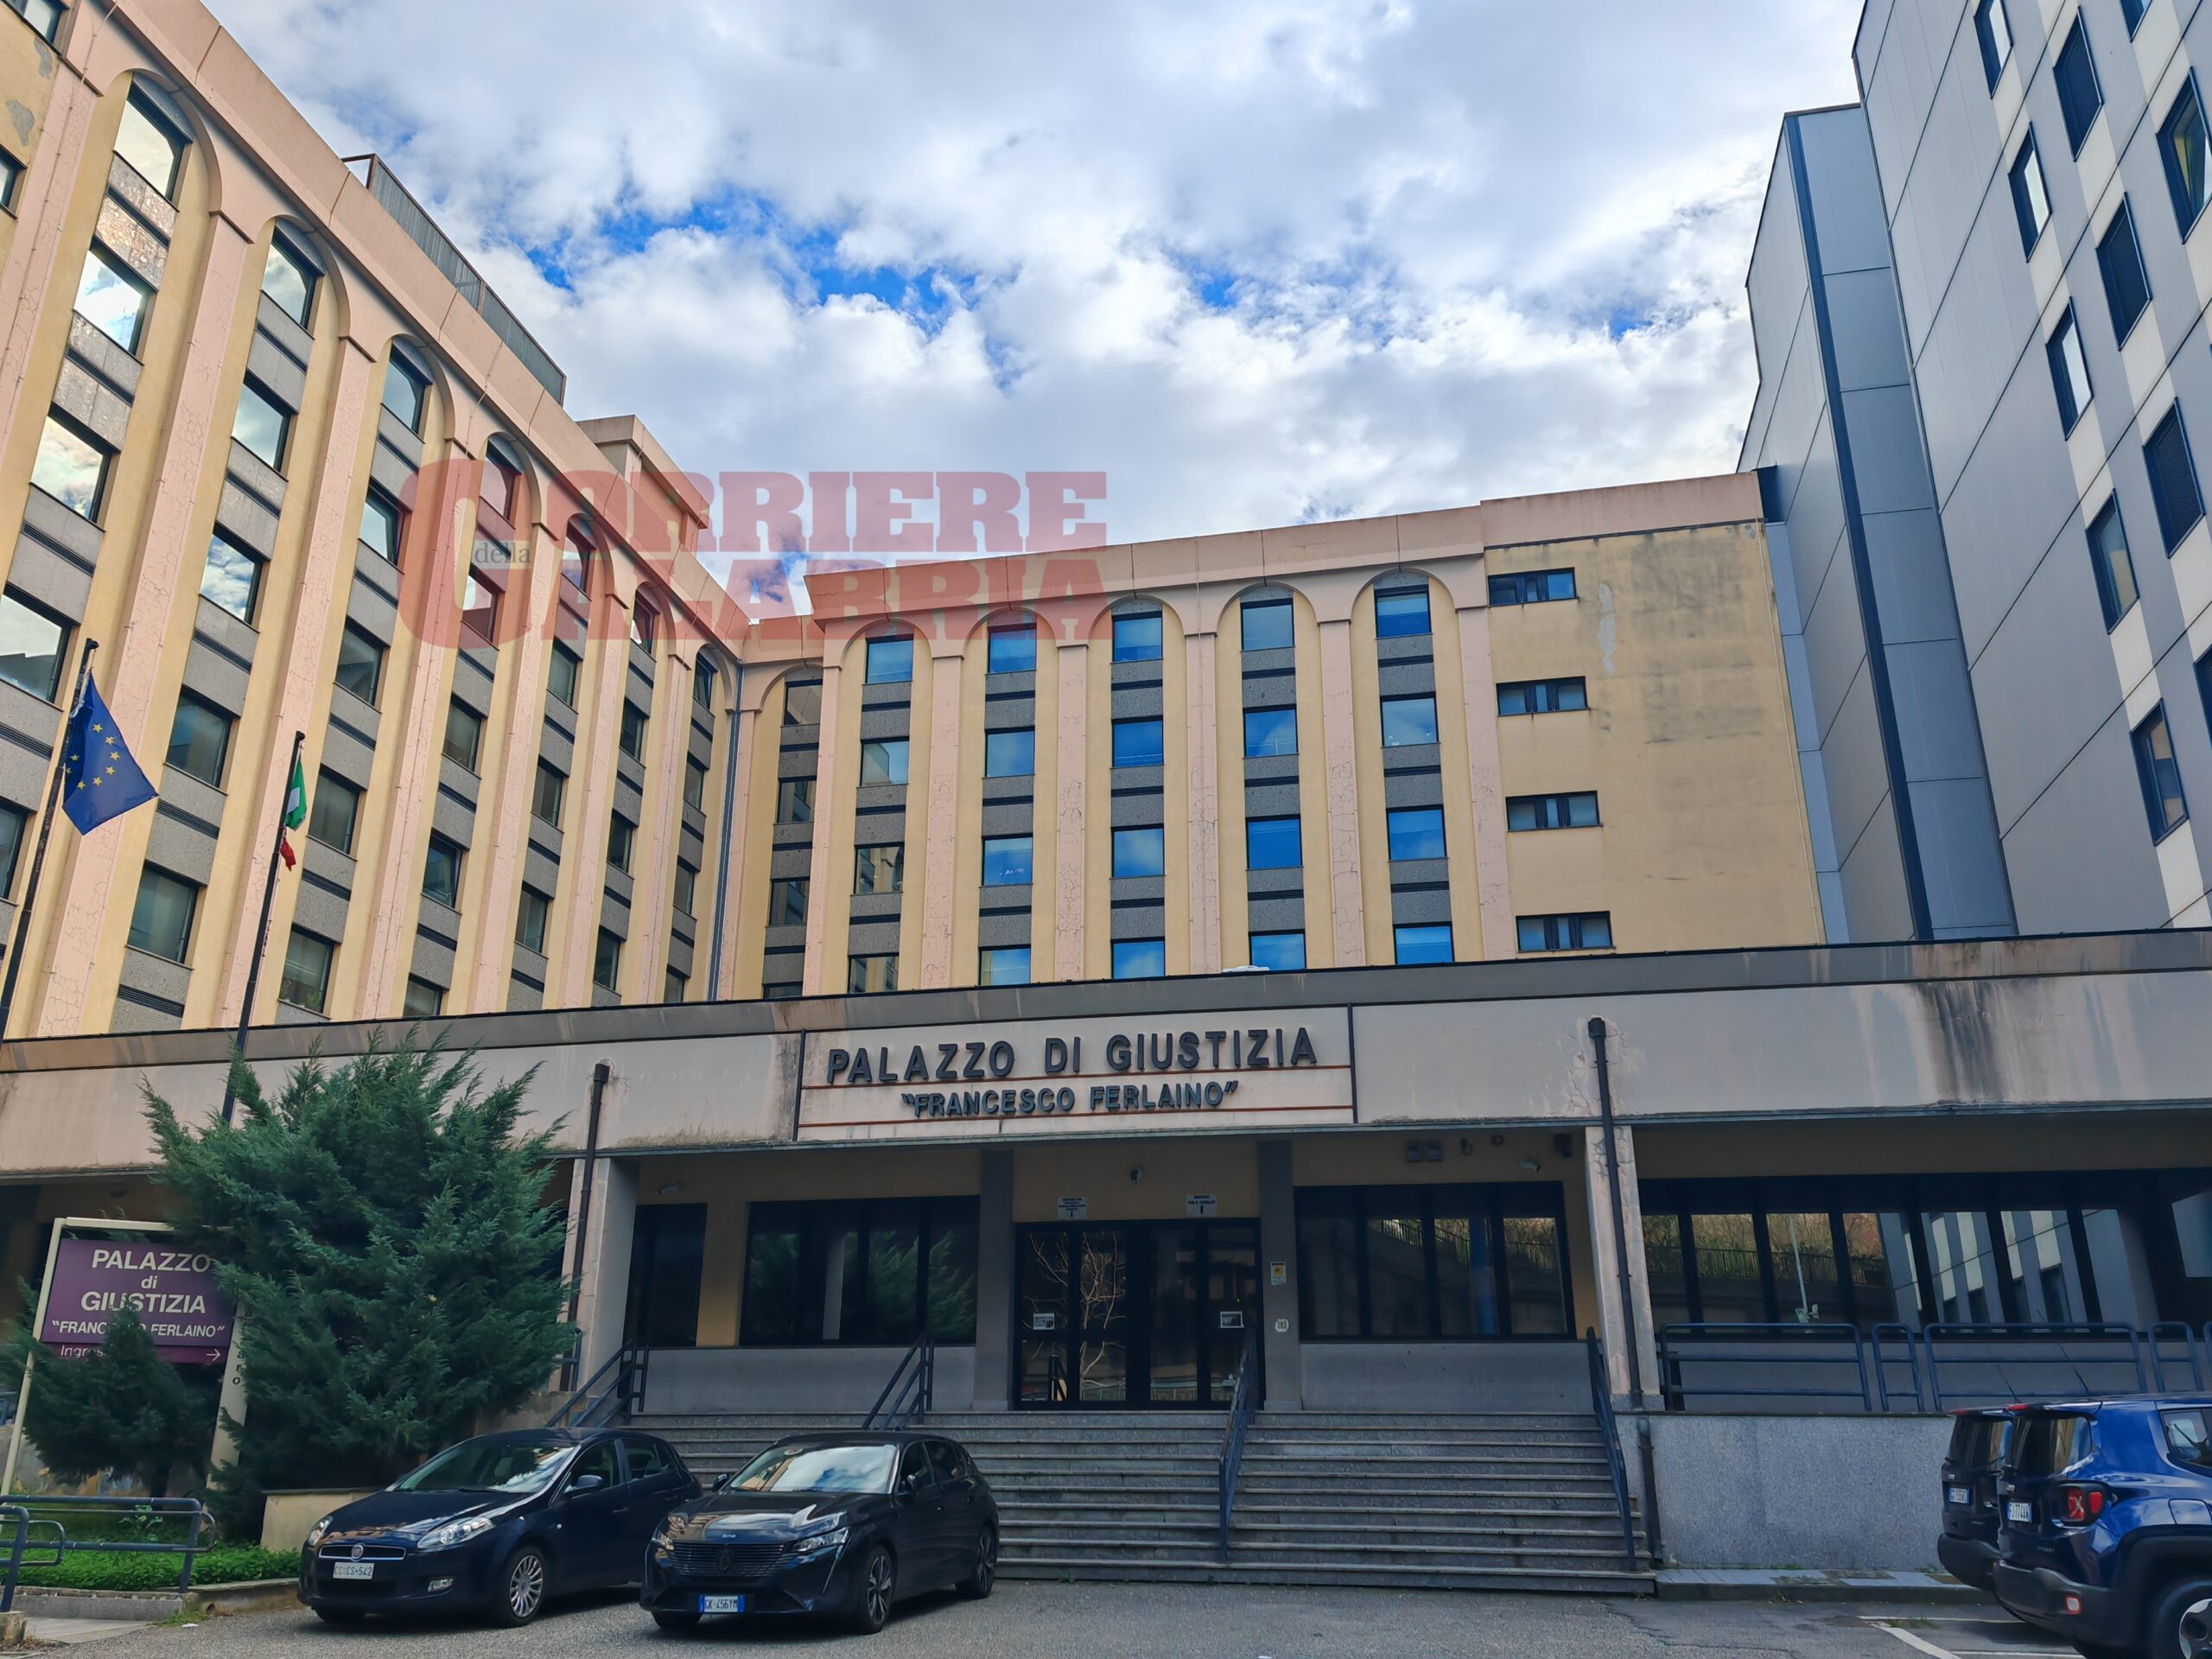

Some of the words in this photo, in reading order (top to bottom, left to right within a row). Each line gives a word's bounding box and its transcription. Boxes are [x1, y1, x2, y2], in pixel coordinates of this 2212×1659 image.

[827, 1040, 1014, 1084] PALAZZO
[1045, 1036, 1081, 1075] DI
[1106, 1027, 1318, 1072] GIUSTIZIA
[92, 1249, 211, 1273] PALAZZO
[141, 1275, 158, 1289] di
[81, 1291, 206, 1314] GIUSTIZIA
